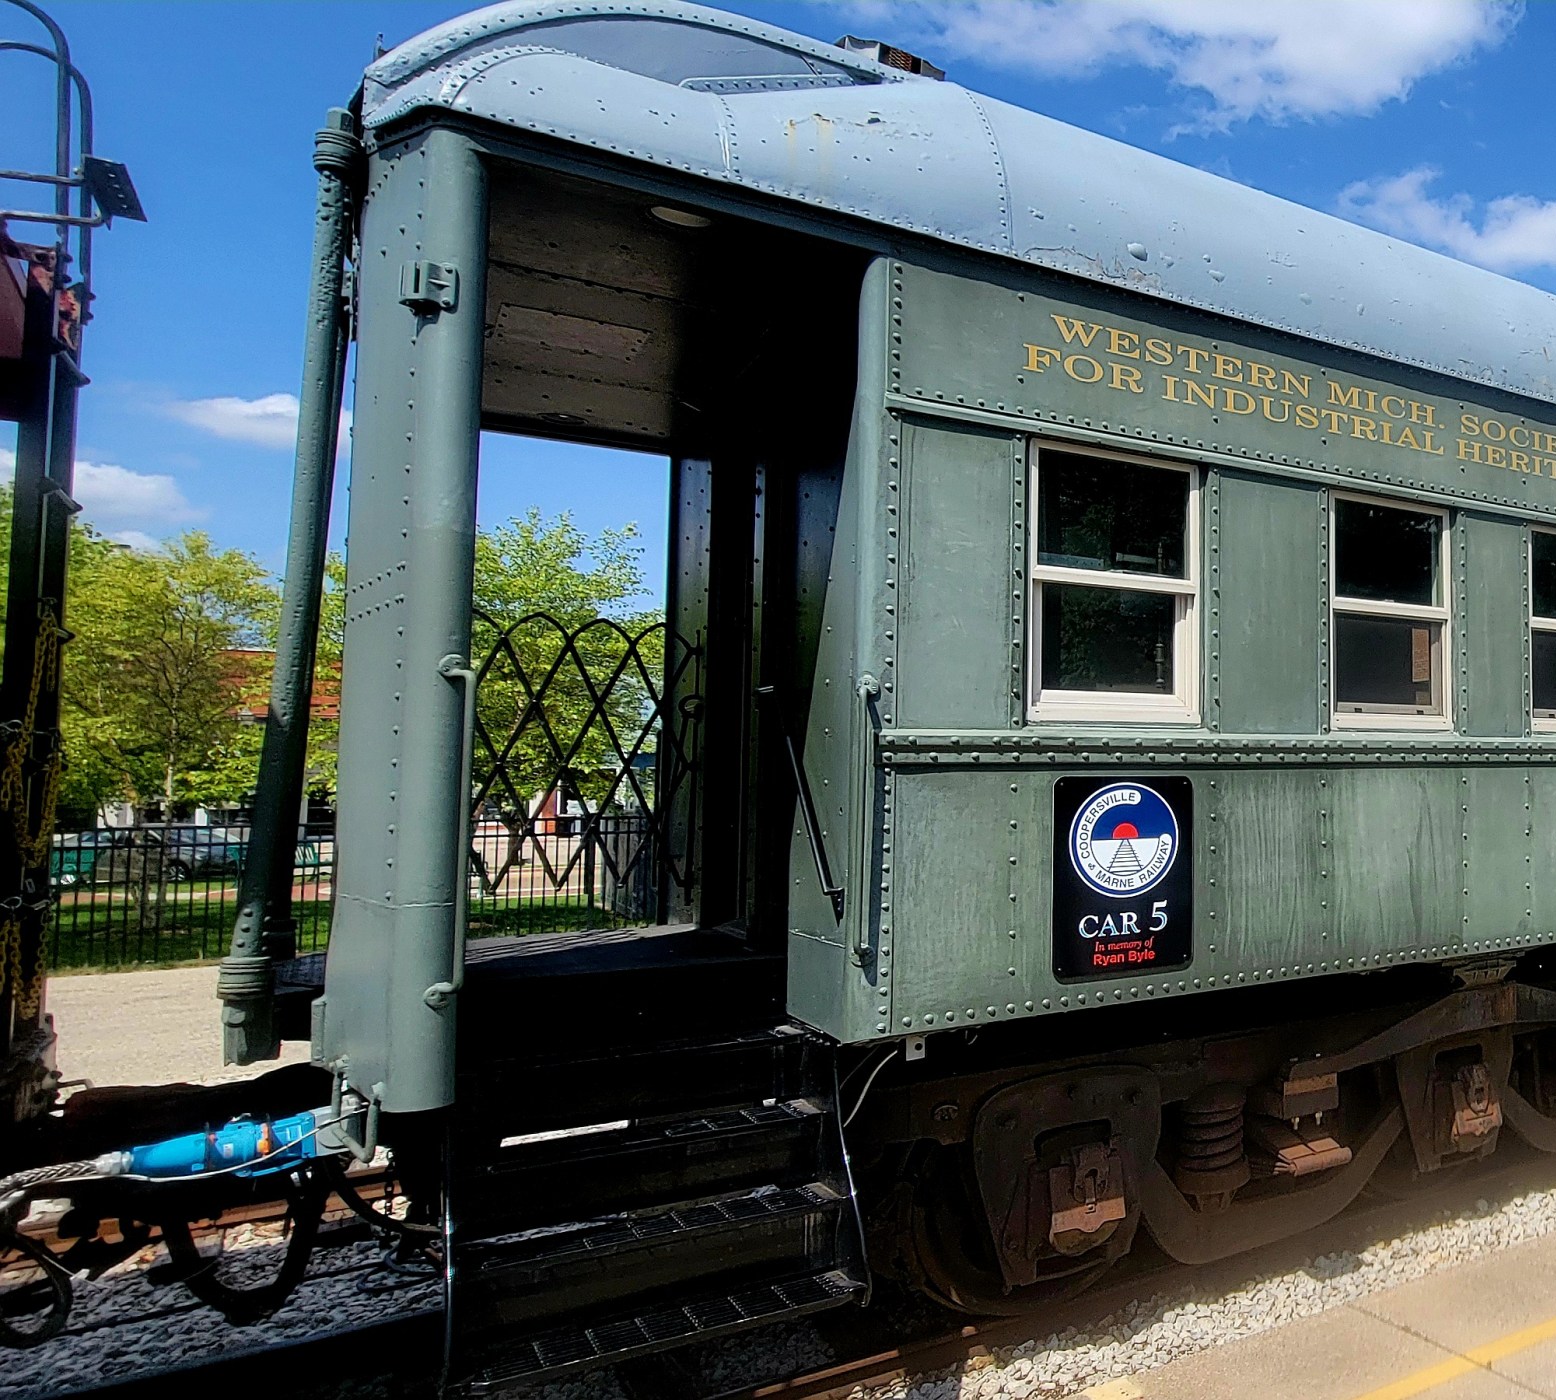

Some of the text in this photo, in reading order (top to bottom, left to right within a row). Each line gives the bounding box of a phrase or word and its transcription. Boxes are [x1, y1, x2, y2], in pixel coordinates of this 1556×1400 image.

[1022, 343, 1145, 394] FOR
[1162, 374, 1445, 456] INDUSTRIAL
[1050, 313, 1312, 399] WESTERN
[1326, 380, 1446, 429] MICH.
[1079, 792, 1170, 888] COOPERSVILLE & MARNE RAILWAY
[1078, 899, 1168, 938] CAR 5
[1094, 935, 1155, 953] In memory of
[1093, 948, 1156, 966] Ryan Byle
